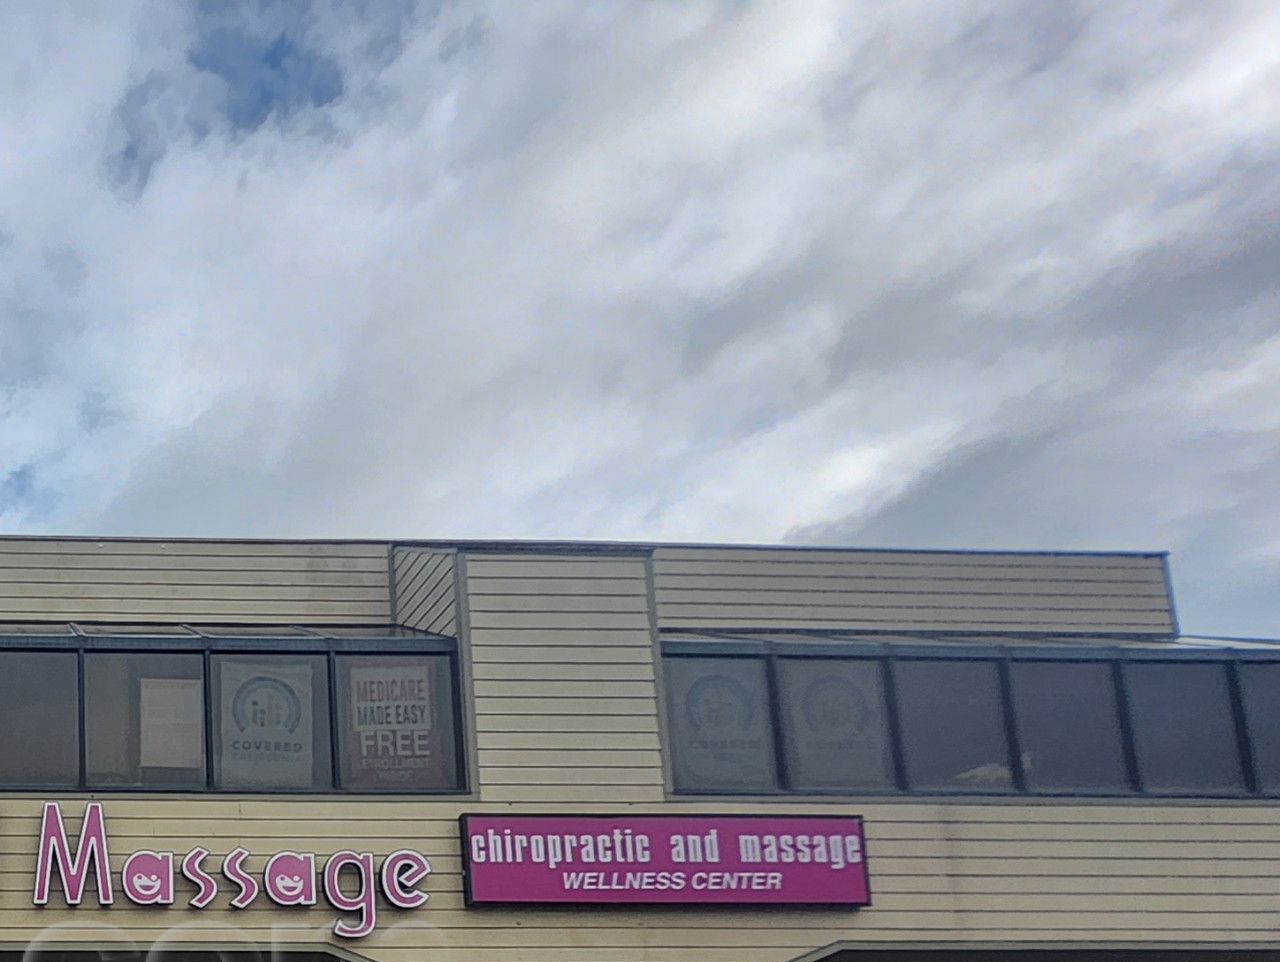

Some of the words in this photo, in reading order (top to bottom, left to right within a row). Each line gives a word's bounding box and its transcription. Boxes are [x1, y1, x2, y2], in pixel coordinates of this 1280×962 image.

[356, 679, 425, 703] MEDICARE
[357, 705, 392, 726] MADE
[395, 704, 426, 725] EASY
[231, 740, 303, 752] COVERED
[360, 731, 430, 756] FREE
[471, 829, 651, 868] chiropractic
[670, 829, 720, 863] and
[738, 834, 861, 869] massage
[33, 800, 432, 938] Massage
[562, 872, 686, 889] WELLNESS
[691, 872, 783, 889] CENTER
